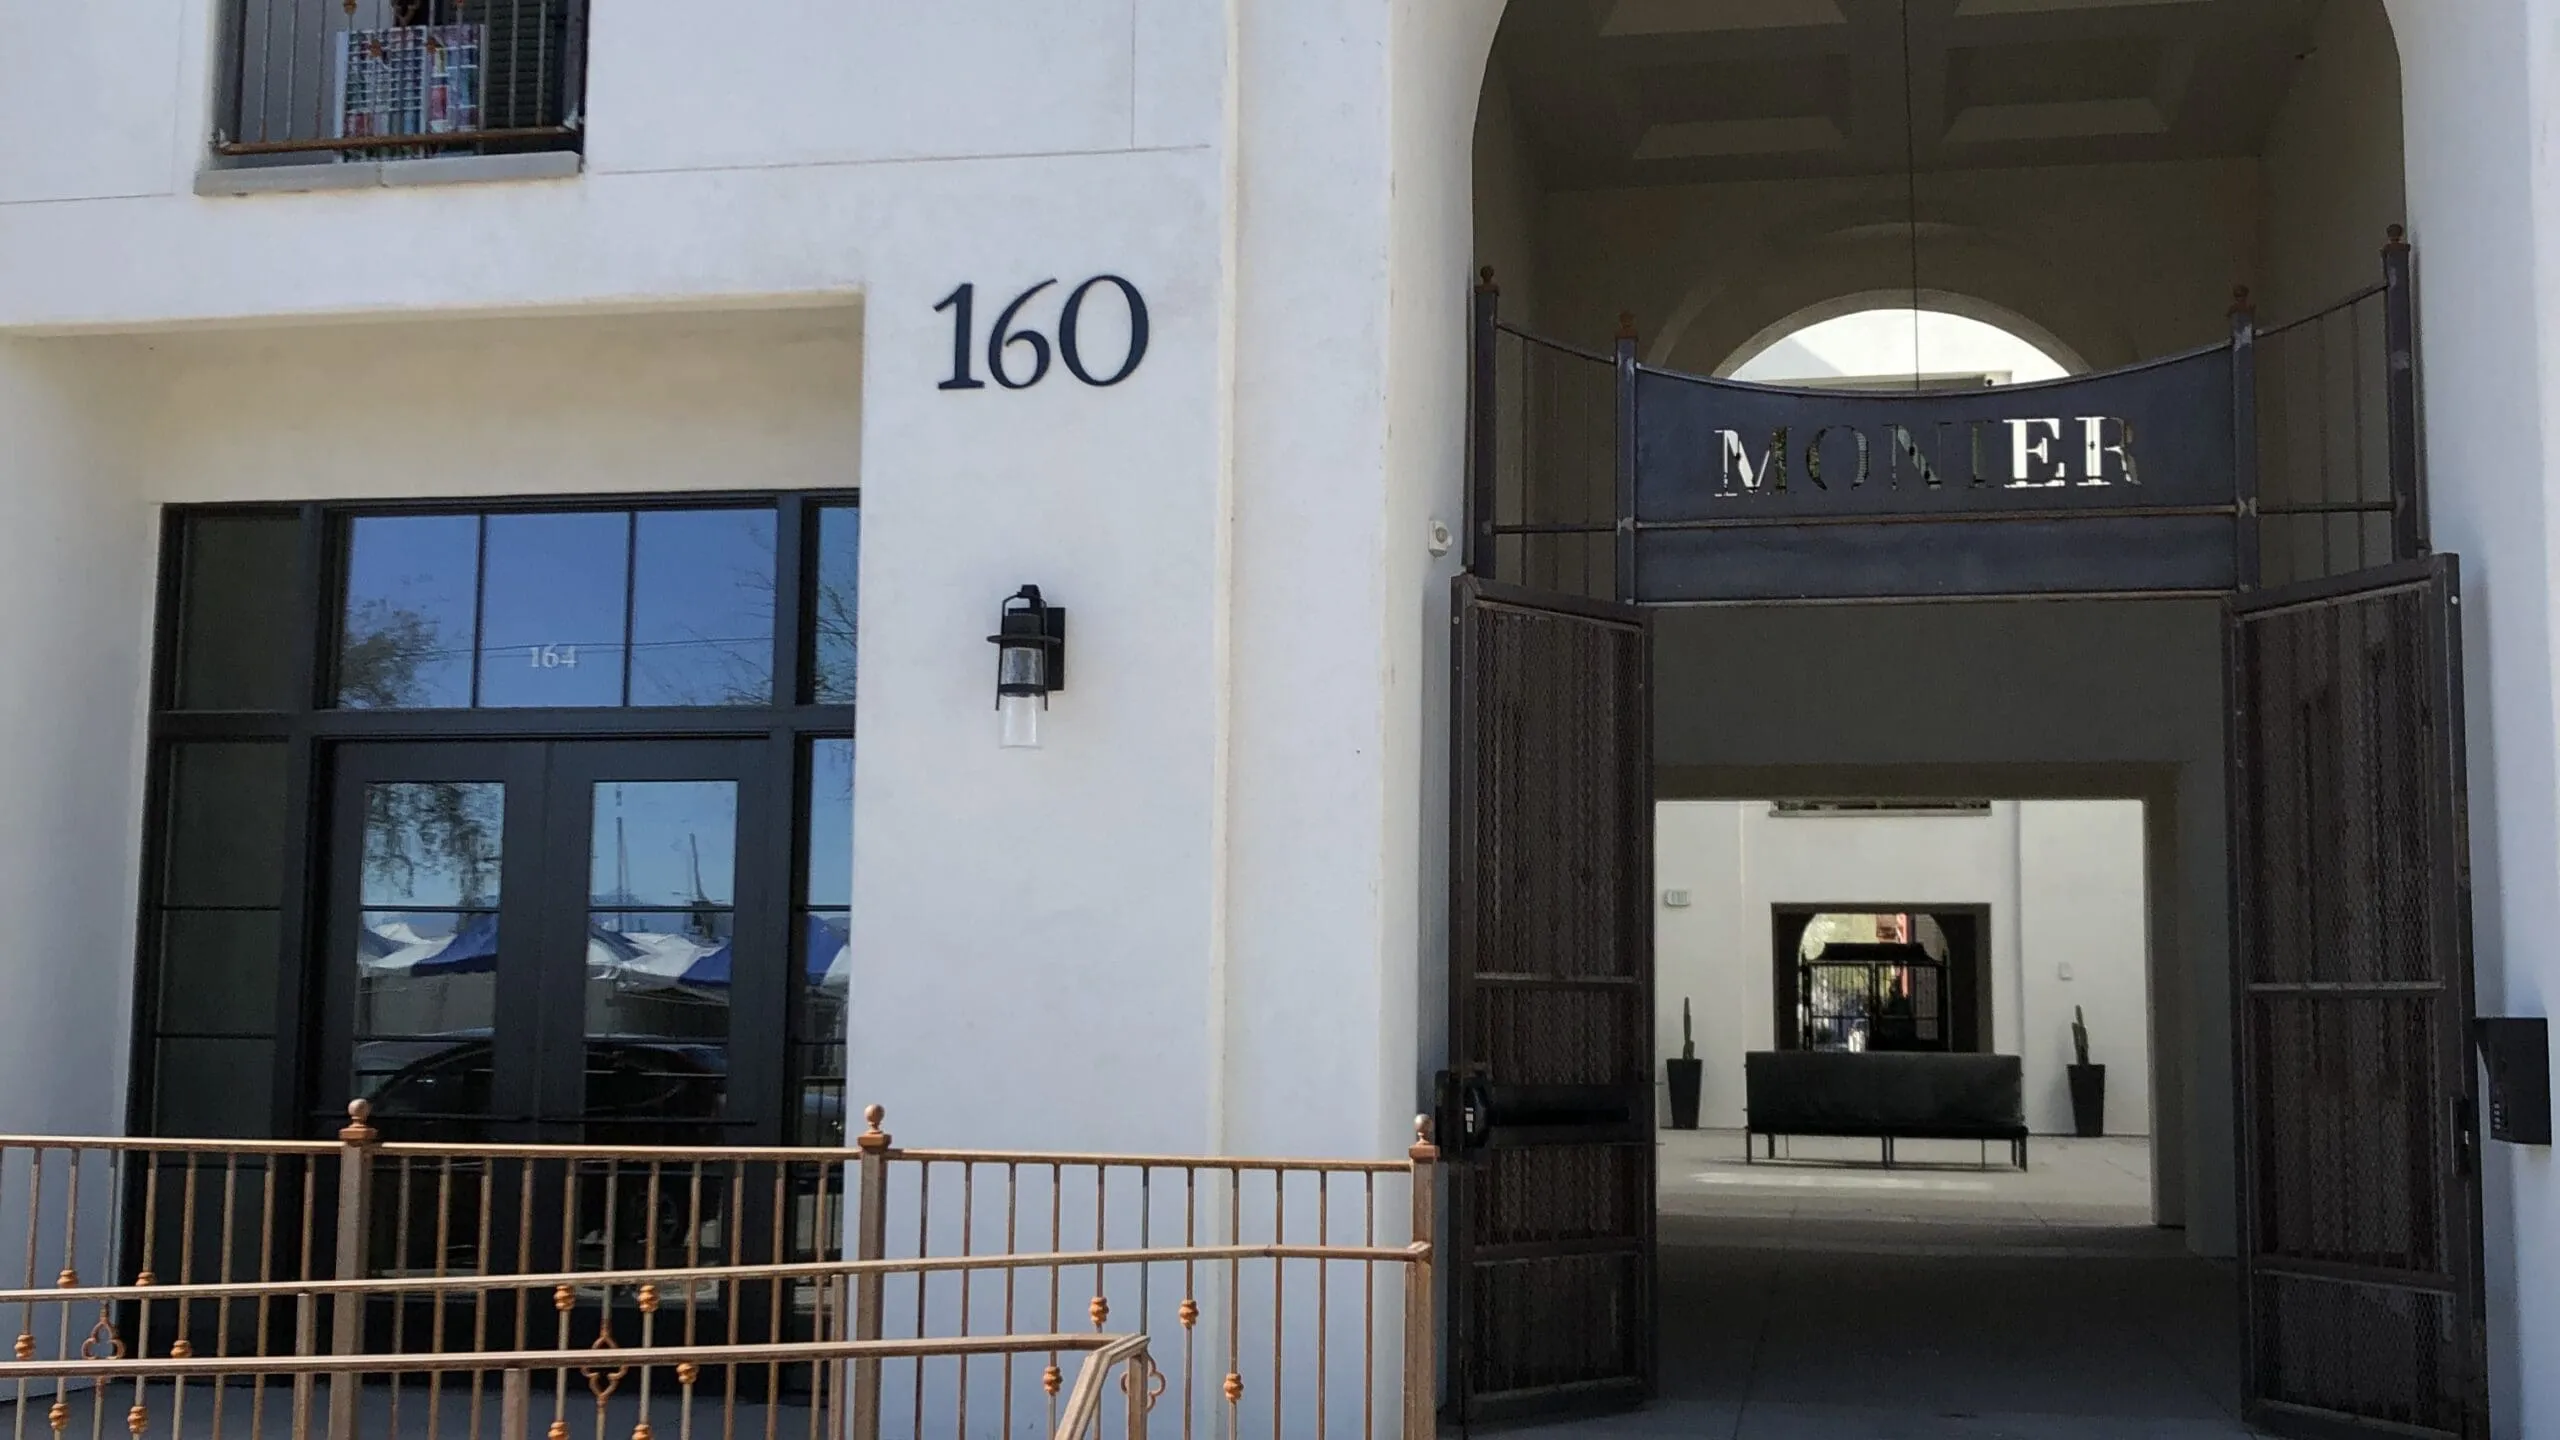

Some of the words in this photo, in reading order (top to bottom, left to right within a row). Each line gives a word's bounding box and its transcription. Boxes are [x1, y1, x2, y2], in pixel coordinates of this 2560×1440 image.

[933, 274, 1149, 390] 160
[1714, 416, 2142, 497] MONIER
[530, 643, 577, 669] 164
